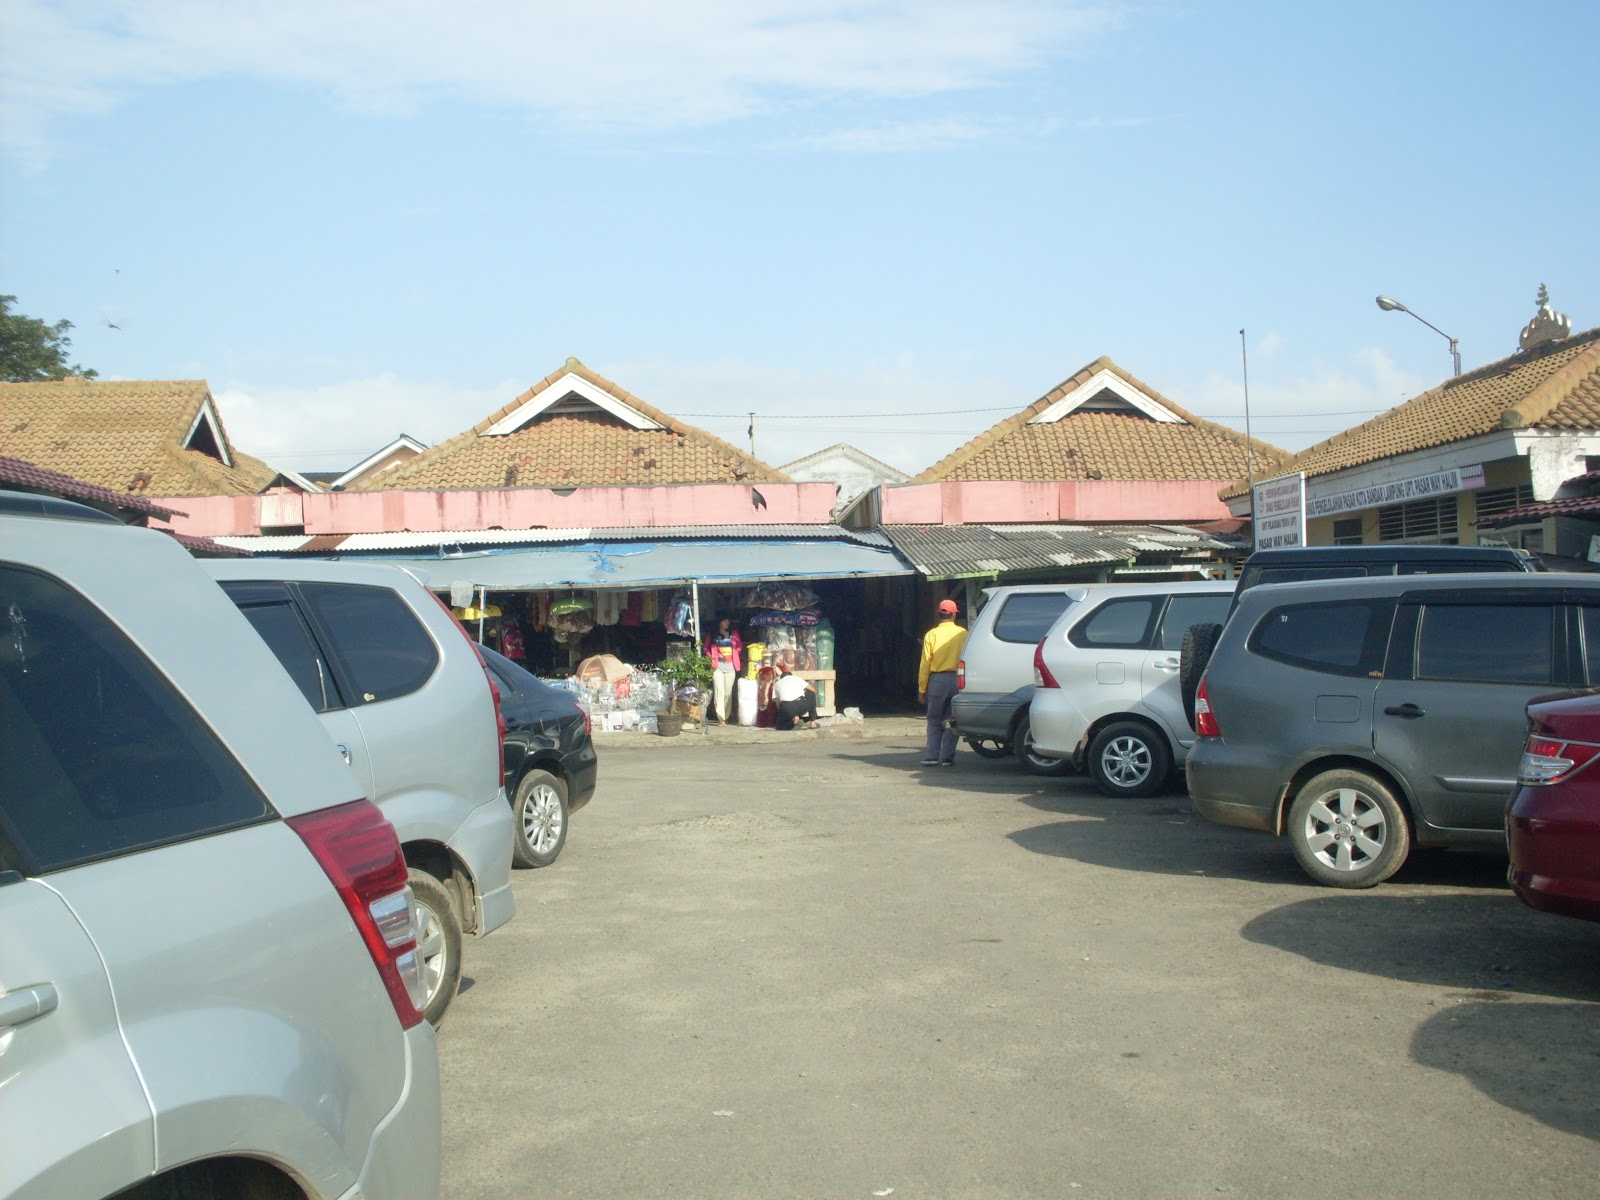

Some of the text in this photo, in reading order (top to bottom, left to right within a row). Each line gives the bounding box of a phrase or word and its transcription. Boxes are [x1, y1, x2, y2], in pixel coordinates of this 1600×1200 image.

[1342, 491, 1357, 510] PASAR
[1355, 490, 1368, 507] KOTA
[1366, 485, 1385, 504] BANDAR
[1383, 481, 1405, 502] LAMPUNG
[1414, 476, 1432, 496] PASAR
[1429, 474, 1443, 493] WAY
[1440, 471, 1459, 491] HALIM
[1258, 532, 1299, 551] PASAR WAY HALIM
